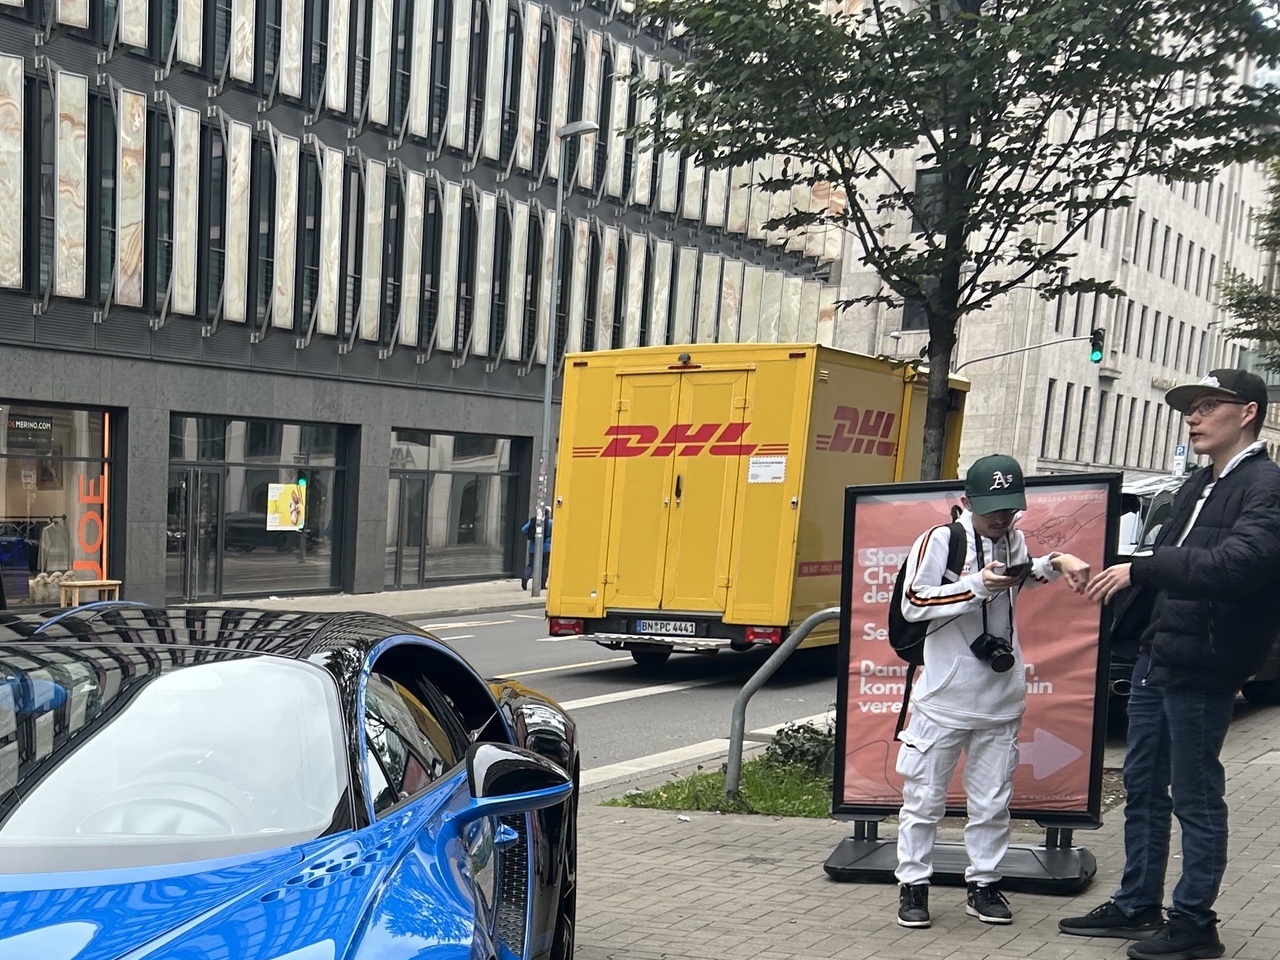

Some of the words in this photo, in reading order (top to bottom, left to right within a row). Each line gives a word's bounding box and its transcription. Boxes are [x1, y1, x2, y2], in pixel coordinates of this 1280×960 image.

[598, 421, 761, 457] DHL
[828, 405, 896, 457] DHL
[641, 621, 654, 631] BN
[659, 622, 671, 632] PC
[672, 623, 695, 634] 4441
